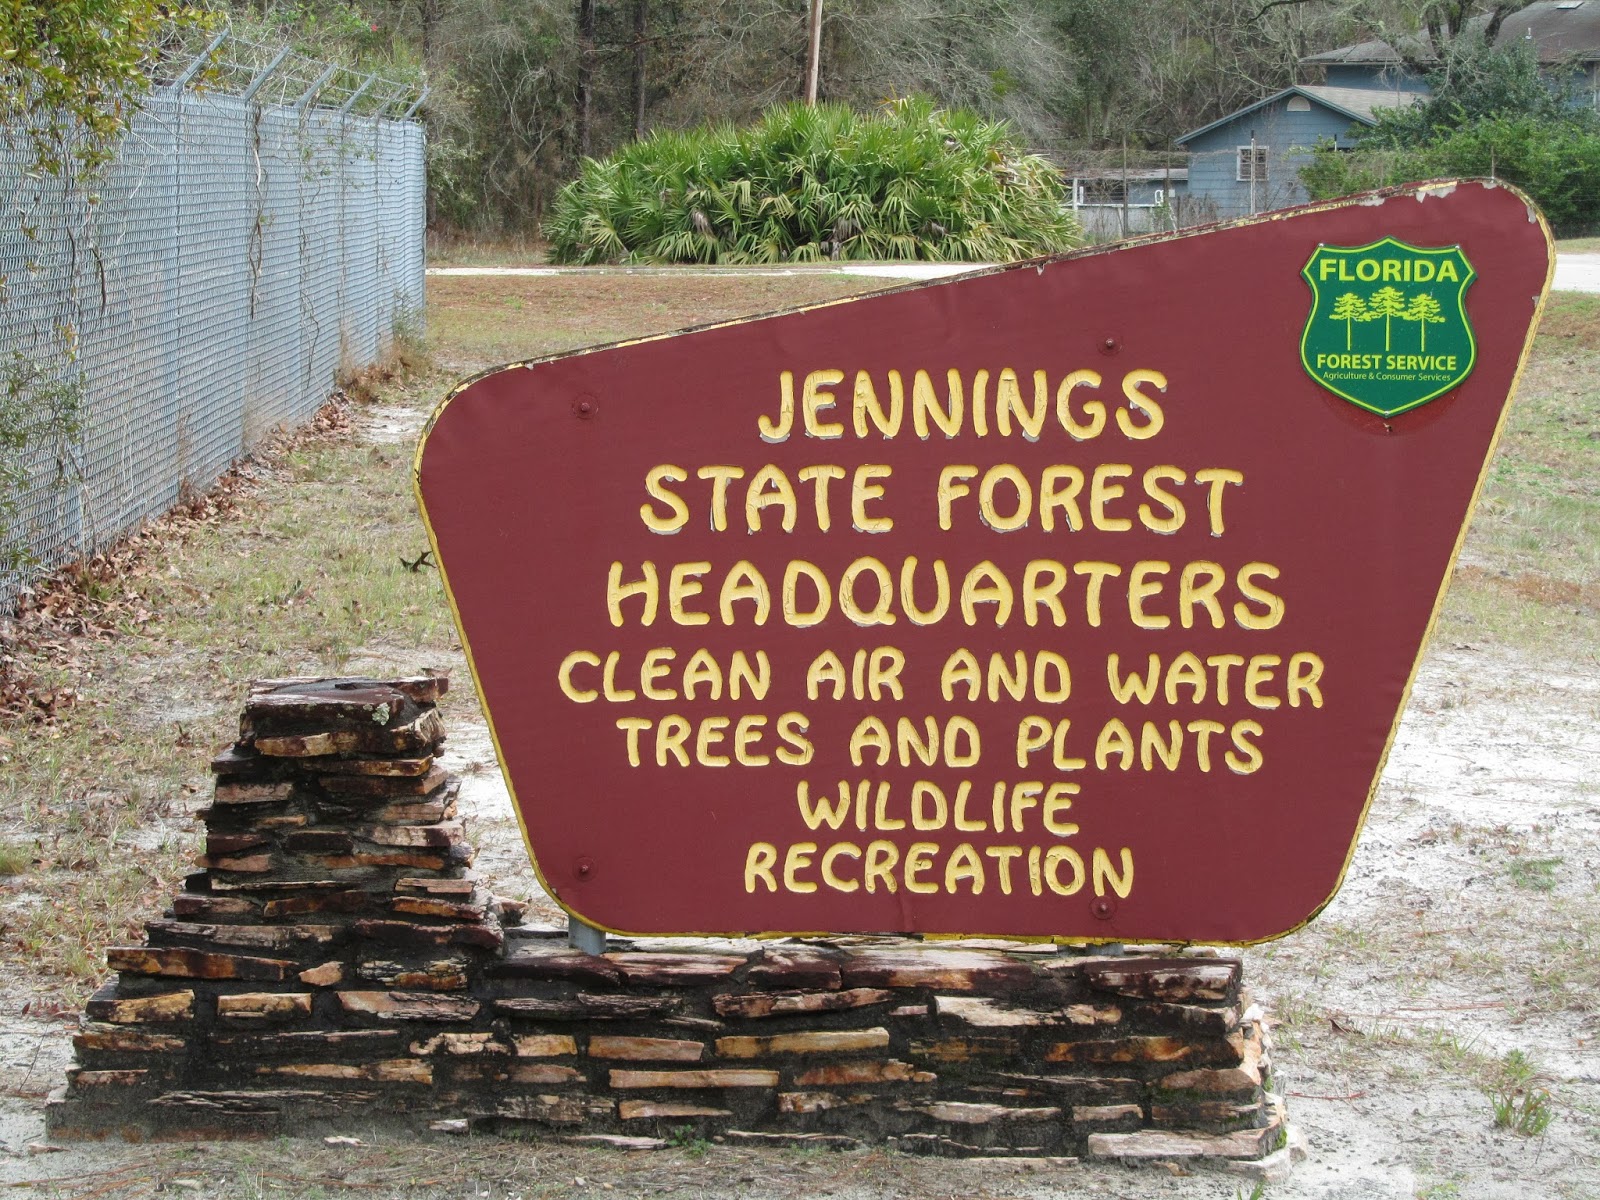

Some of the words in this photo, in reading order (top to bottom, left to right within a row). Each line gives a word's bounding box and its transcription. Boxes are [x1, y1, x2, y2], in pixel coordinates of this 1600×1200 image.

[1319, 258, 1459, 282] FLORIDA
[1316, 354, 1382, 369] FOREST
[1386, 355, 1457, 371] SERVICE
[1322, 371, 1367, 381] Agriculture
[1376, 372, 1416, 381] Consumer
[1418, 373, 1451, 382] Services
[758, 368, 1167, 443] JENNINGS
[640, 464, 893, 535] STATE
[938, 464, 1243, 537] FOREST
[606, 556, 1285, 629] HEADQUARTERS
[558, 647, 770, 703] CLEAN
[806, 646, 905, 702] AIR
[941, 648, 1072, 704] AND
[1107, 652, 1324, 709] WATER
[616, 712, 814, 767] TREES
[850, 716, 981, 767] AND
[1016, 716, 1264, 775] PLANTS
[797, 780, 1081, 837] WILDLIFE
[745, 840, 1134, 898] RECREATION
